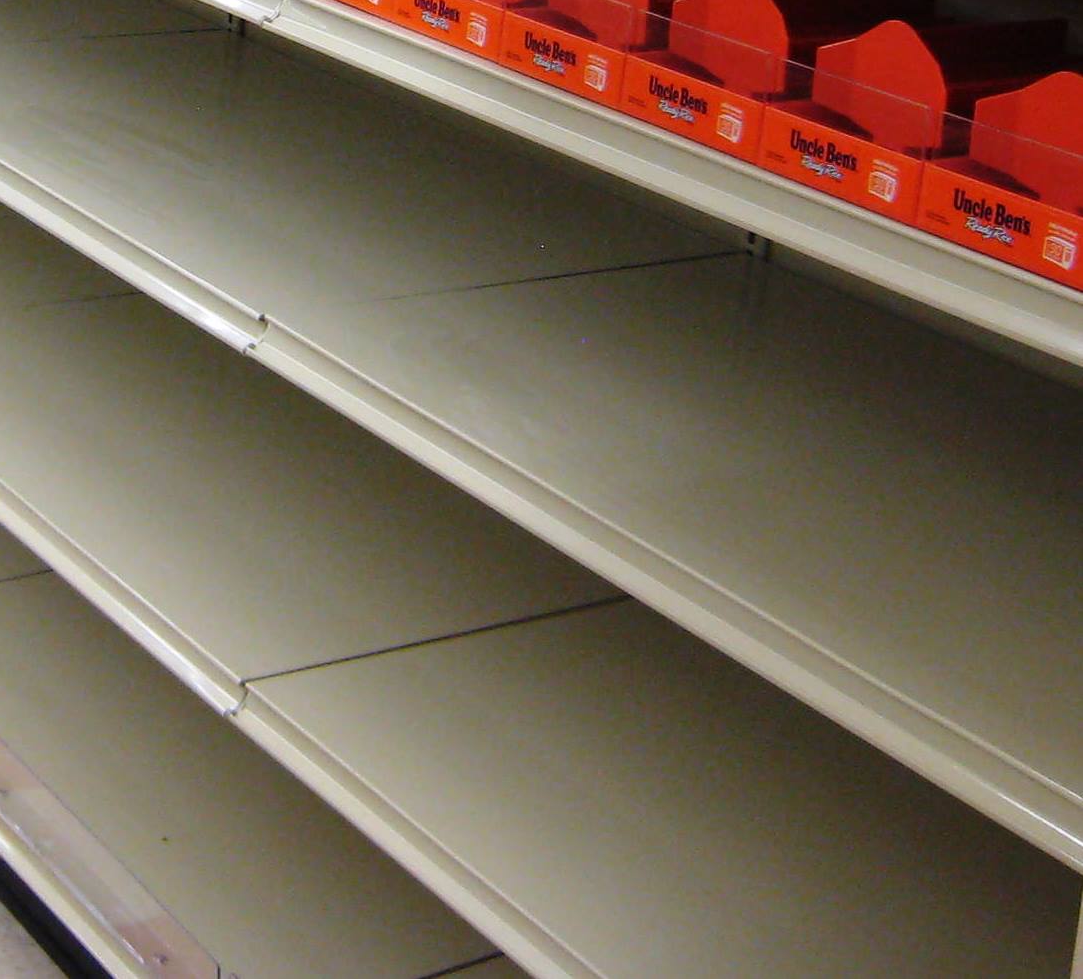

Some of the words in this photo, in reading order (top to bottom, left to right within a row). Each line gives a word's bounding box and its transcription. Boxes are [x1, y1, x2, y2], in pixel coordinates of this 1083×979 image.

[525, 32, 552, 58] Uncle
[649, 75, 679, 103] Uncle
[679, 88, 708, 115] Ben's
[791, 129, 825, 159] Uncle
[826, 142, 858, 171] Ben's
[954, 189, 993, 221] Uncle
[994, 203, 1032, 235] Ben's
